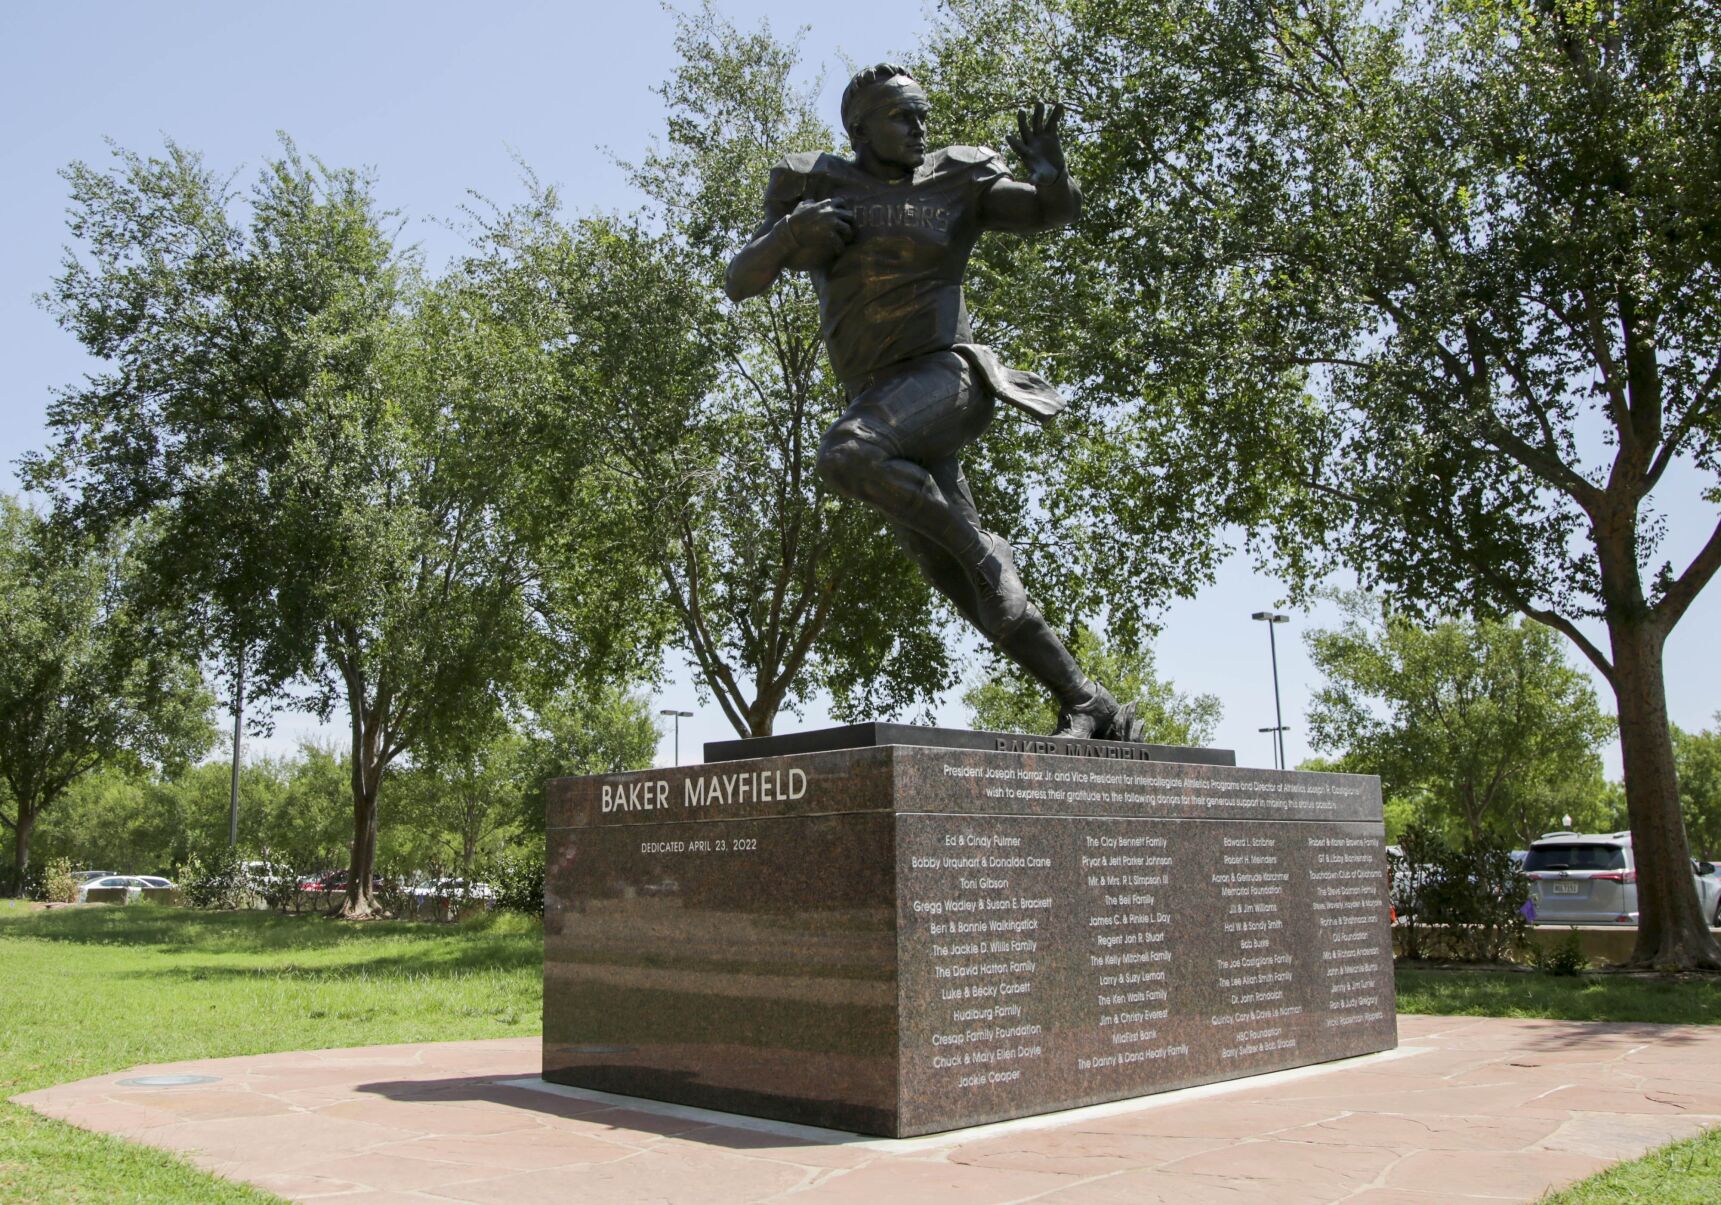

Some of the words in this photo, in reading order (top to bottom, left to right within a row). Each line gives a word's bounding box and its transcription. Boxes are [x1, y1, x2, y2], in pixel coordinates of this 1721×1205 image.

[996, 738, 1057, 754] BAKER
[1066, 744, 1150, 760] MAYFIELD
[944, 764, 983, 777] President
[985, 769, 1015, 780] Joseph
[1045, 770, 1053, 780] Jr.
[1055, 772, 1070, 781] and
[1071, 772, 1088, 782] Vice
[1090, 773, 1122, 784] President
[1124, 775, 1133, 784] for
[1135, 776, 1182, 788] Intercollegiate
[1184, 778, 1209, 789] Athletics
[1241, 782, 1252, 790] and
[602, 780, 669, 812] BAKER
[684, 768, 806, 806] MAYFIELD
[986, 787, 1004, 797] wish
[1006, 787, 1015, 797] to
[1017, 790, 1046, 800] express
[1048, 789, 1065, 799] their
[1067, 791, 1100, 802] gratitude
[1102, 792, 1109, 801] to
[1111, 792, 1122, 801] the
[1124, 792, 1155, 805] following
[1157, 794, 1180, 804] donors
[1182, 795, 1190, 804] for
[1191, 795, 1206, 804] their
[642, 841, 684, 853] DEDICATED
[688, 840, 711, 852] APRIL
[733, 838, 756, 850] 2022
[946, 835, 956, 846] Ed
[958, 835, 964, 846] &
[967, 835, 990, 848] Cindy
[994, 835, 1020, 846] Fulmer
[912, 857, 940, 869] Bobby
[981, 857, 987, 867] &
[1027, 857, 1051, 867] Crane
[960, 878, 977, 889] Toni
[979, 878, 1008, 888] Gibson
[913, 901, 941, 913] Gregg
[944, 900, 976, 912] Wadley
[979, 899, 984, 910] &
[987, 899, 1010, 909] Susan
[1013, 898, 1019, 908] E.
[1021, 898, 1052, 908] Brackett
[931, 923, 947, 934] Ben
[950, 922, 955, 933] &
[958, 921, 987, 933] Bonnie
[989, 919, 1038, 932] Walkingstick
[933, 944, 948, 956] The
[951, 943, 979, 955] Jackie
[980, 942, 988, 953] D.
[990, 941, 1010, 952] Willis
[1011, 940, 1036, 952] Family
[935, 967, 950, 978] The
[953, 965, 978, 976] David
[980, 964, 1008, 975] Hatton
[1010, 961, 1036, 972] Family
[942, 988, 962, 1000] Luke
[964, 986, 970, 998] &
[972, 985, 997, 997] Becky
[1000, 982, 1030, 994] Corbett
[954, 1008, 993, 1021] Hudiburg
[995, 1004, 1021, 1016] Family
[932, 1034, 964, 1046] Cresap
[967, 1029, 993, 1041] Family
[995, 1024, 1041, 1038] Foundation
[933, 1055, 962, 1068] Chuck
[964, 1053, 970, 1064] &
[972, 1051, 995, 1063] Mary
[997, 1048, 1016, 1060] Ellen
[1018, 1045, 1041, 1058] Doyle
[958, 1075, 986, 1087] Jackie
[988, 1070, 1020, 1083] Cooper
